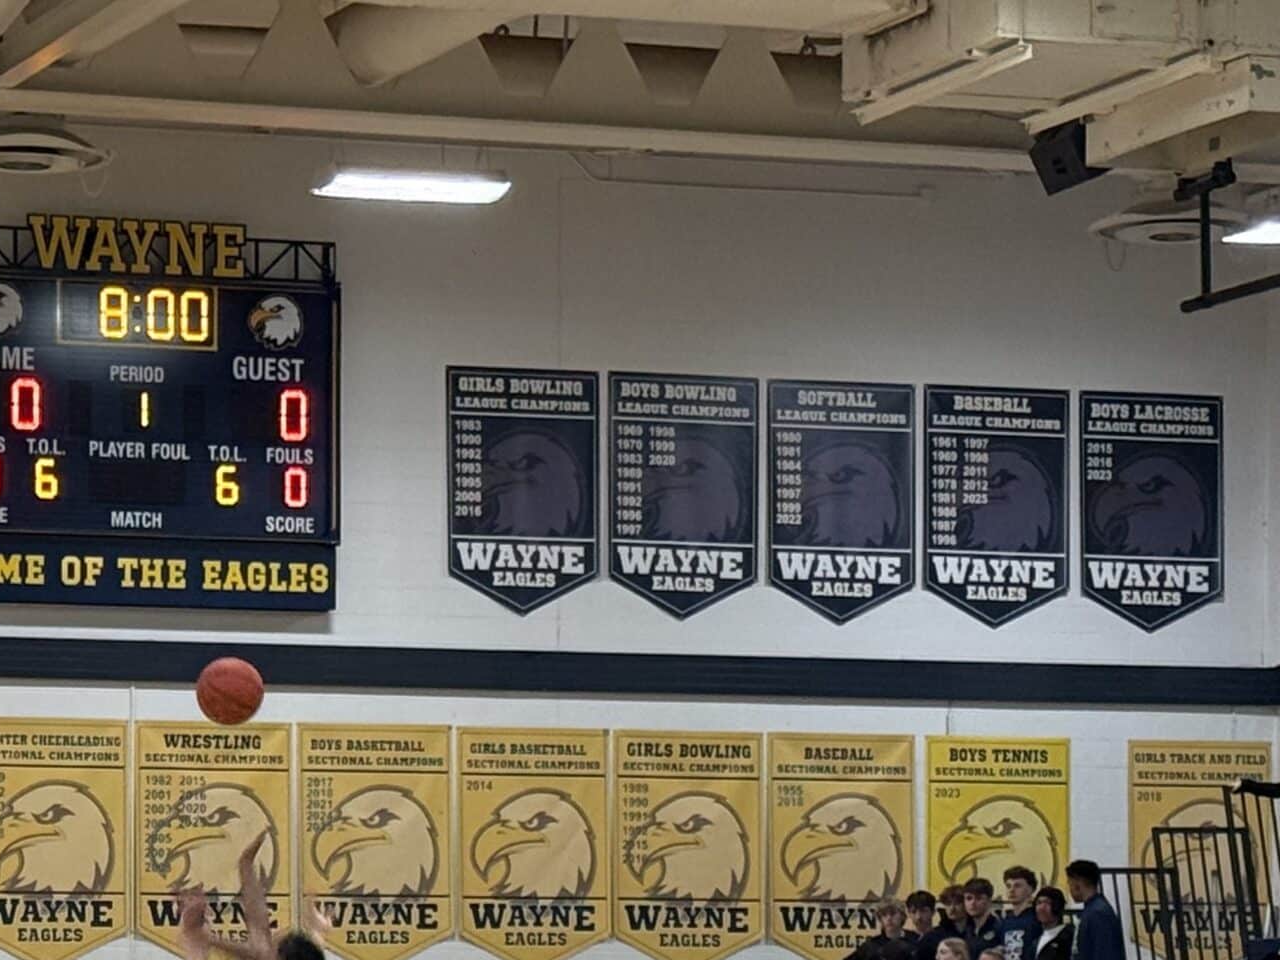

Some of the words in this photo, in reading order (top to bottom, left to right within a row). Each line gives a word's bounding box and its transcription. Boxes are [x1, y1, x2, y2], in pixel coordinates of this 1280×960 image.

[28, 213, 246, 278] WAYNE
[99, 286, 209, 342] 8:00
[110, 366, 164, 383] PERIOD
[233, 357, 304, 382] GUEST
[459, 377, 504, 393] GIRLS
[510, 378, 583, 396] BOWLING
[621, 382, 659, 398] BOYS
[665, 385, 736, 402] BOWLING
[11, 377, 42, 431] 0
[456, 398, 507, 409] LEAGUE
[511, 399, 590, 412] CHAMPIONS
[798, 391, 876, 407] SOFTBALL
[140, 392, 149, 427] 1
[280, 388, 309, 443] 0
[618, 403, 668, 415] LEAGUE
[672, 405, 749, 418] CHAMPIONS
[777, 410, 825, 421] LEAGUE
[831, 411, 906, 424] CHAMPIONS
[1091, 403, 1129, 418] BOYS
[1135, 404, 1210, 422] LACROSSE
[932, 414, 982, 426] LEAGUE
[986, 417, 1060, 429] CHAMPIONS
[1088, 422, 1136, 433] LEAGUE
[1140, 423, 1214, 436] CHAMPIONS
[27, 438, 65, 455] T.O.L.
[89, 441, 145, 458] PLAYER
[152, 443, 190, 461] FOUL
[209, 445, 246, 463] T.O.L.
[267, 448, 313, 464] FOULS
[35, 458, 58, 500] 6
[1087, 470, 1112, 480] 2023
[216, 465, 239, 506] 6
[284, 466, 307, 508] 0
[111, 512, 162, 529] MATCH
[266, 516, 314, 534] SCORE
[457, 543, 584, 575] WAYNE
[618, 547, 743, 579] WAYNE
[61, 556, 104, 585] OF
[117, 558, 186, 589] THE
[203, 561, 329, 593] EAGLES
[777, 552, 901, 584] WAYNE
[933, 557, 1055, 588] WAYNE
[493, 572, 556, 588] EAGLES
[652, 576, 714, 592] EAGLES
[1089, 561, 1209, 593] WAYNE
[812, 582, 872, 597] EAGLES
[967, 586, 1026, 601] EAGLES
[1121, 591, 1181, 606] EAGLES
[31, 735, 121, 747] CHEERLEADING
[164, 734, 261, 749] WRESTLING
[311, 739, 341, 750] BOYS
[346, 740, 424, 752] BASKETBALL
[49, 751, 119, 761] CHAMPIONS
[470, 743, 505, 754] GIRLS
[510, 744, 586, 756] BASKETBALL
[627, 742, 673, 757] GIRLS
[680, 745, 751, 759] BOWLING
[804, 747, 874, 762] BASEBALL
[949, 748, 986, 763] BOYS
[992, 749, 1048, 764] TENNIS
[145, 753, 210, 763] SECTIONAL
[215, 754, 283, 764] CHAMPIONS
[307, 757, 372, 765] SECTIONAL
[376, 757, 443, 766] CHAMPIONS
[1135, 753, 1166, 764] GIRLS
[1170, 754, 1205, 764] TRACK
[1209, 755, 1232, 764] AND
[1235, 755, 1266, 765] FIELD
[623, 762, 685, 772] SECTIONAL
[689, 763, 754, 773] CHAMPIONS
[935, 767, 995, 777] SECTIONAL
[1000, 768, 1063, 778] CHAMPIONS
[146, 776, 171, 785] 1982
[470, 904, 595, 931] WAYNE
[625, 905, 748, 933] WAYNE
[780, 906, 878, 933] WAYN
[18, 929, 83, 942] EAGLES
[346, 931, 410, 944] EAGLES
[505, 933, 567, 946] EAGLES
[660, 934, 720, 947] EAGLES
